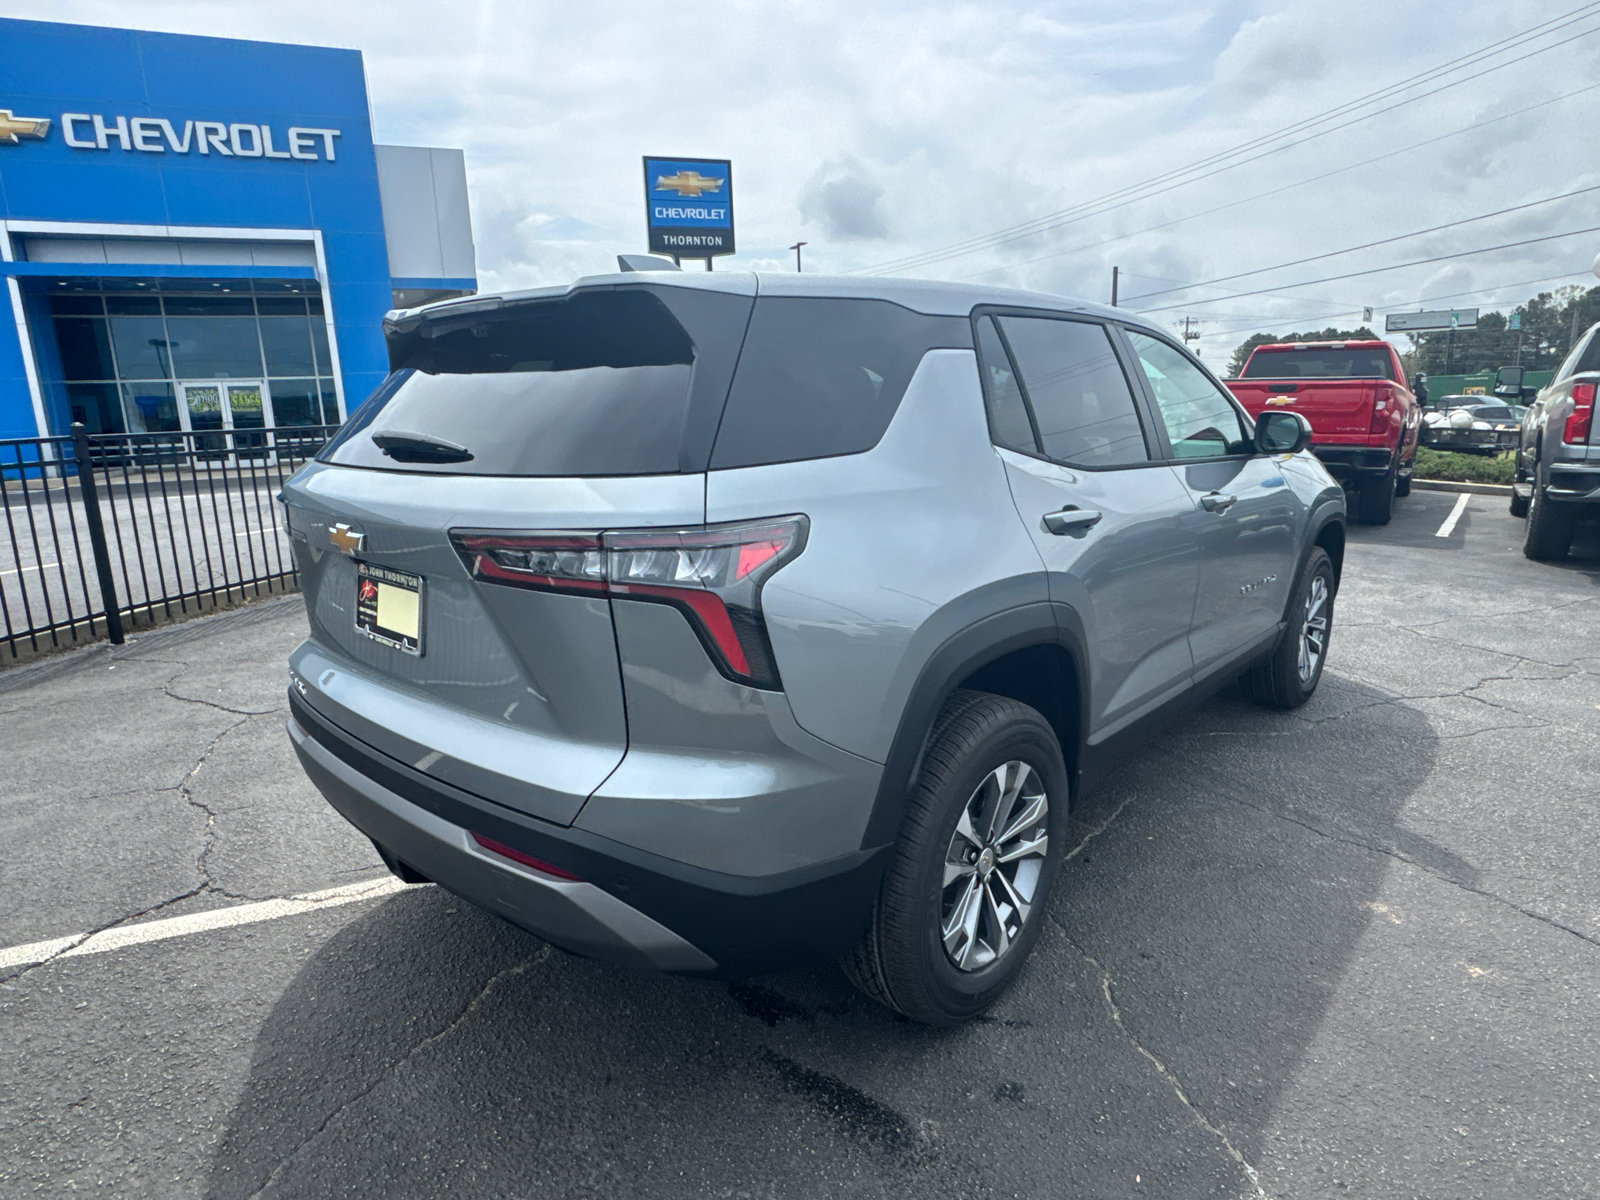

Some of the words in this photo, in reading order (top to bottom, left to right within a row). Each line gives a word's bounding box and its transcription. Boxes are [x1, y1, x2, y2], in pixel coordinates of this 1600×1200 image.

[61, 113, 341, 161] CHEVROLET
[655, 207, 726, 219] CHEVROLET
[663, 235, 723, 246] THORNTON
[369, 566, 384, 579] JOHN
[384, 570, 418, 588] THORNTON
